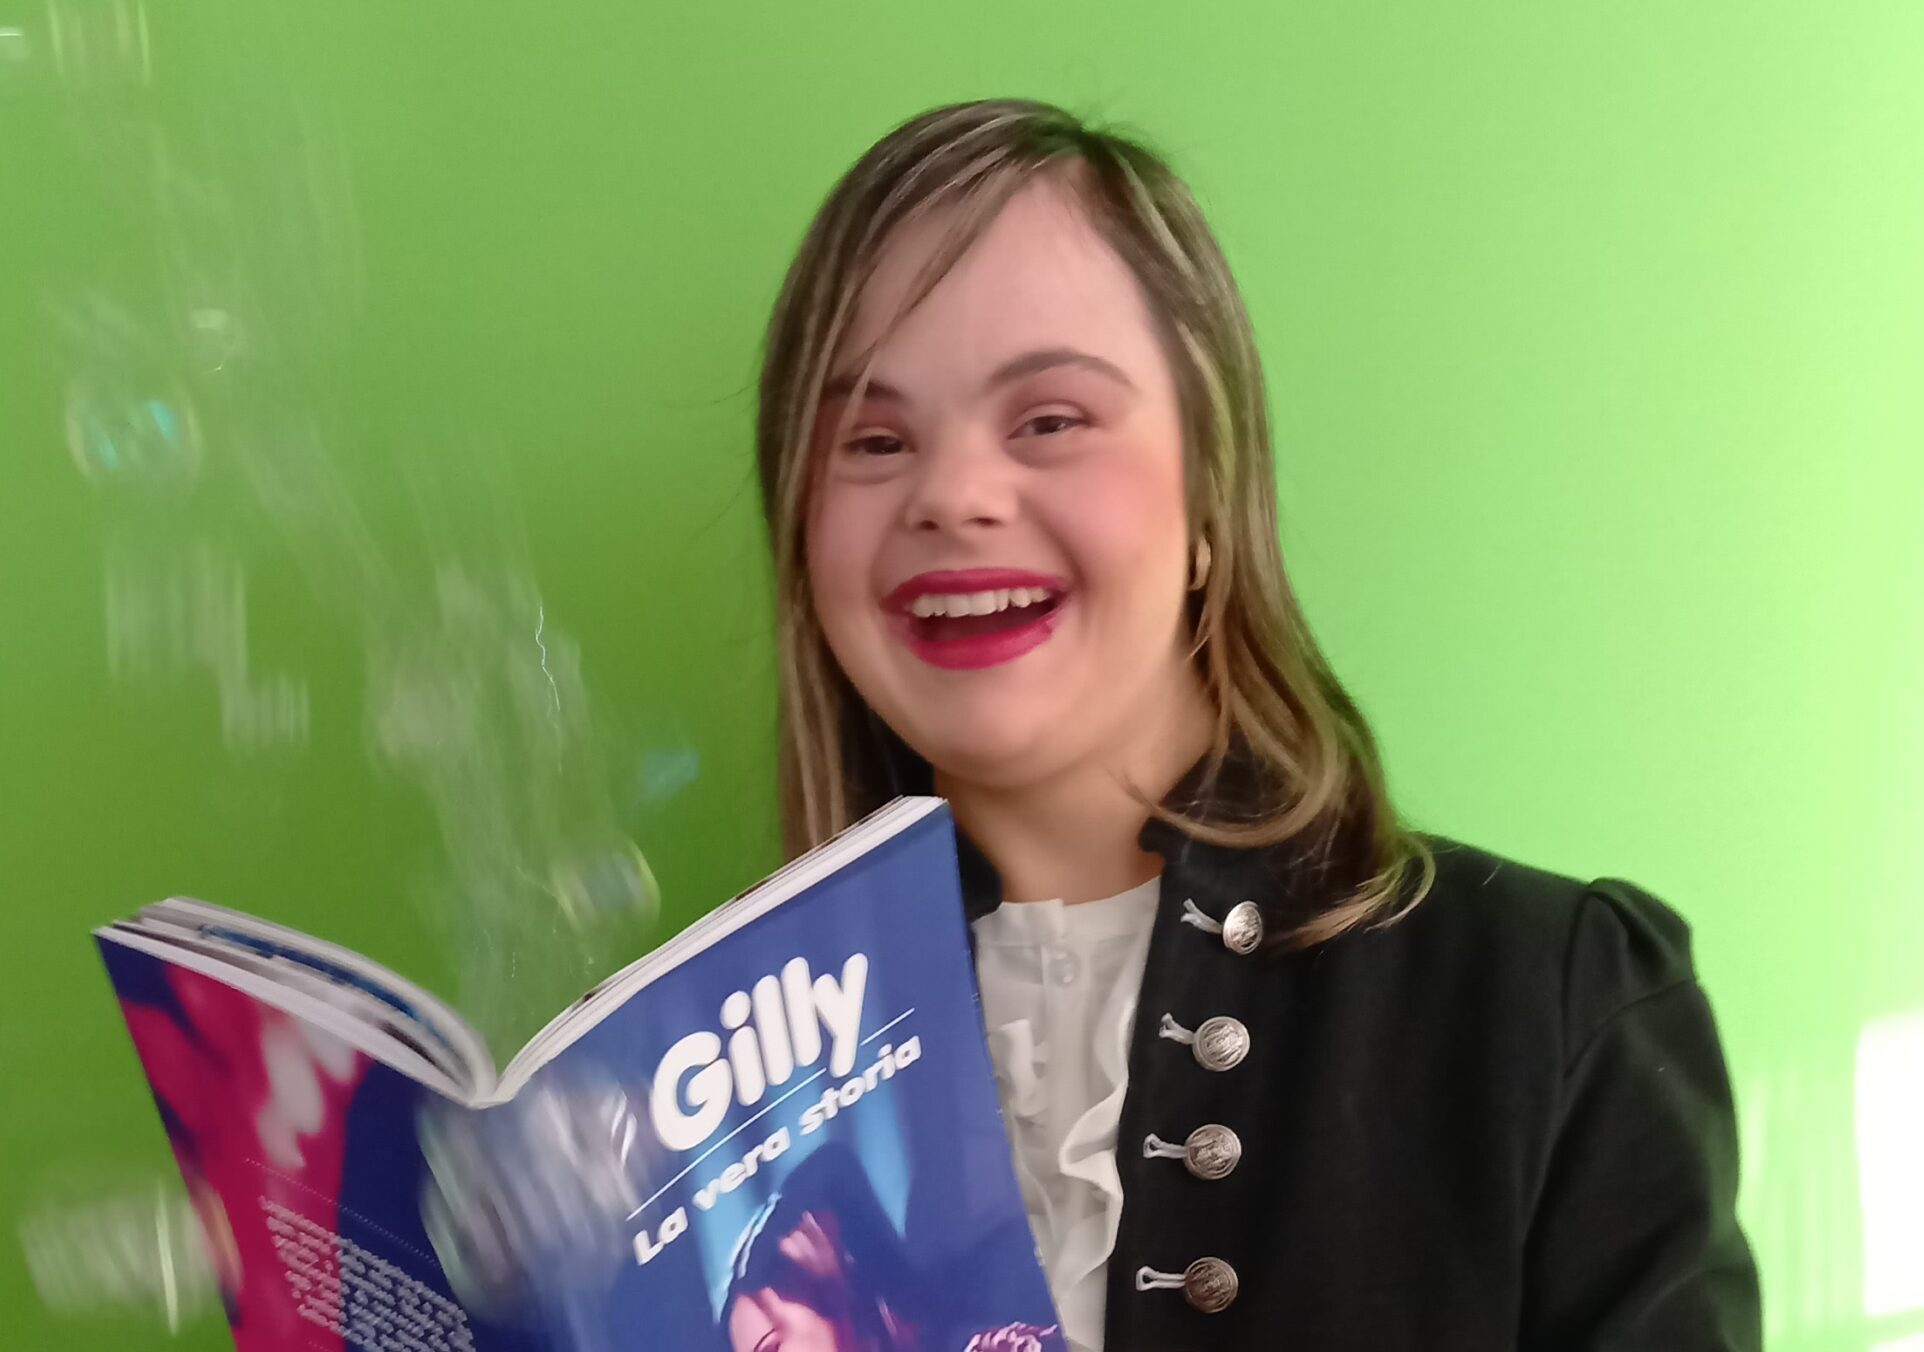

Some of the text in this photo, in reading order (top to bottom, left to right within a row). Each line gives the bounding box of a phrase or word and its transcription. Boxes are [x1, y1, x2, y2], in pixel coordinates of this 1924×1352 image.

[634, 1036, 922, 1265] La vera storia
[652, 954, 867, 1150] Gilly
